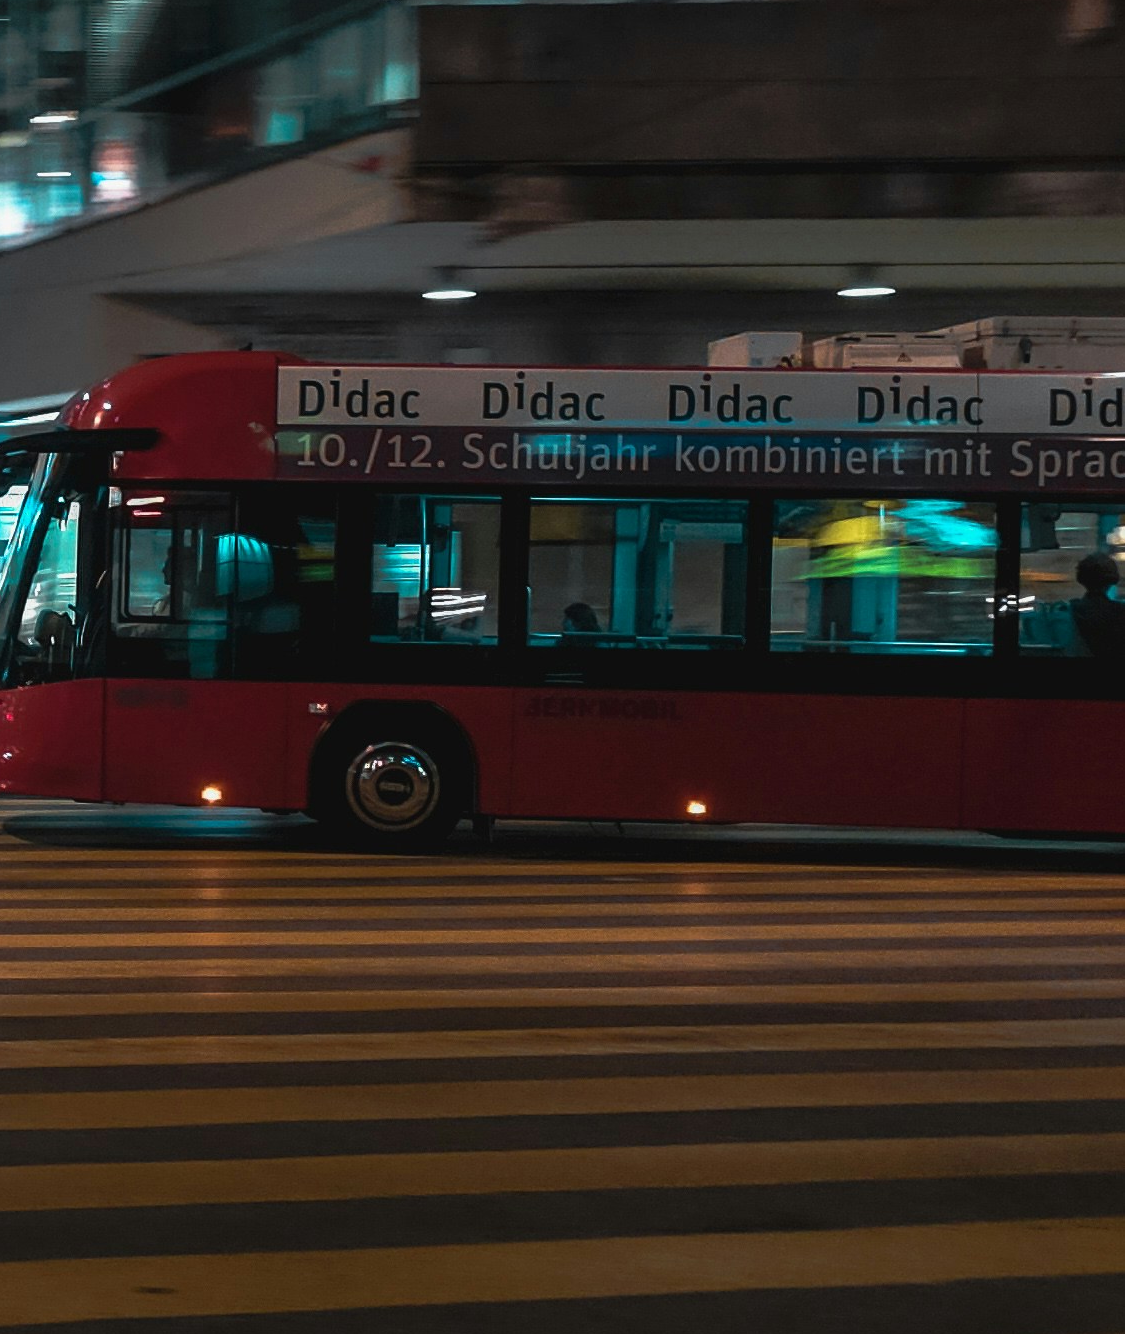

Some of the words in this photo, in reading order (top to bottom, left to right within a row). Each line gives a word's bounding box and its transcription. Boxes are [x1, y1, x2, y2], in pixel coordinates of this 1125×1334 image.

[297, 368, 421, 419] Didac
[481, 370, 606, 421] Didac
[667, 372, 793, 424] Didac
[857, 374, 984, 426] Didac
[296, 429, 446, 474] 10./12.
[461, 432, 657, 480] Schuljahr
[676, 435, 905, 477] kombiniert
[925, 439, 992, 477] mit
